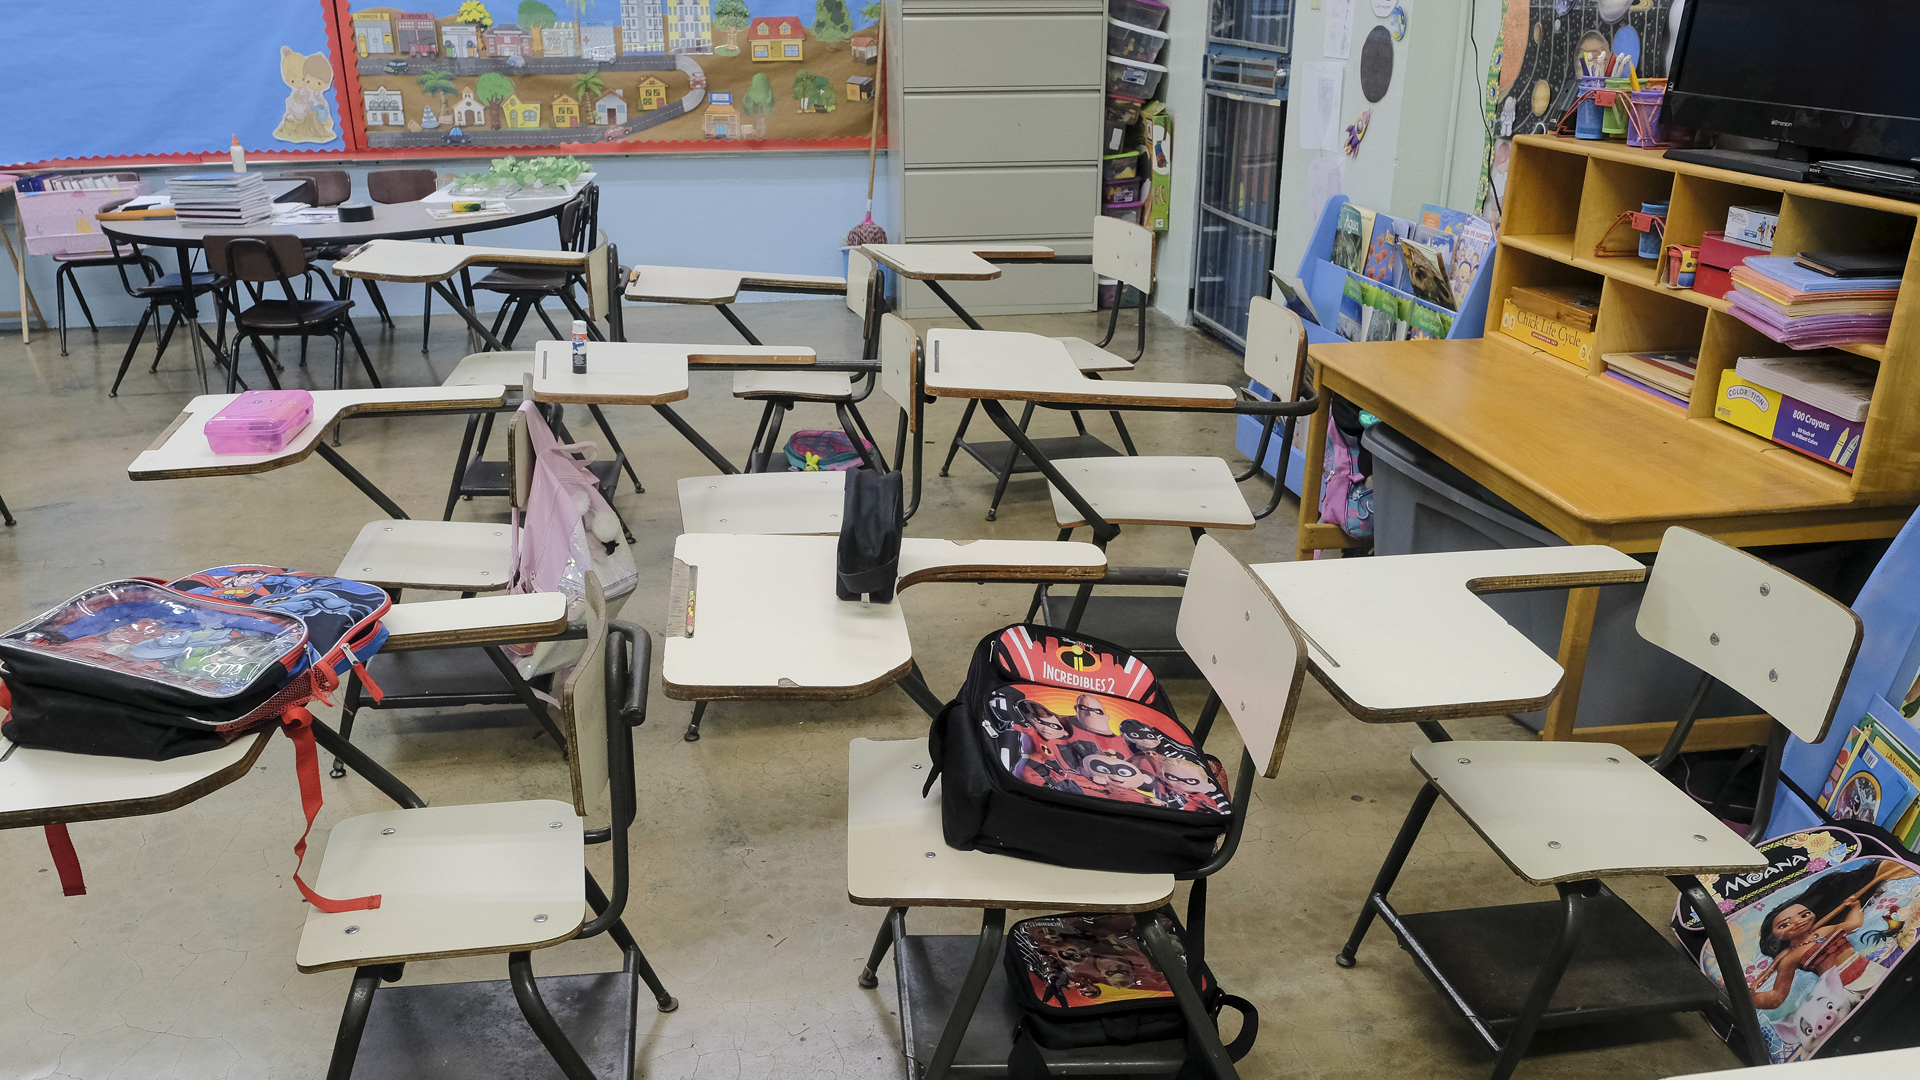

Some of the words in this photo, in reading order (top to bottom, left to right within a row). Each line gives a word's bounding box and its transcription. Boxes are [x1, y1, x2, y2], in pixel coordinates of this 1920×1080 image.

[1517, 309, 1540, 330] Chick
[1540, 318, 1557, 338] Life
[1558, 326, 1581, 348] Cycle
[1792, 409, 1805, 421] 800
[1805, 414, 1831, 431] Crayons
[1042, 660, 1106, 693] INCREDIBLES
[1107, 677, 1115, 695] 2
[1725, 854, 1808, 897] MOANA
